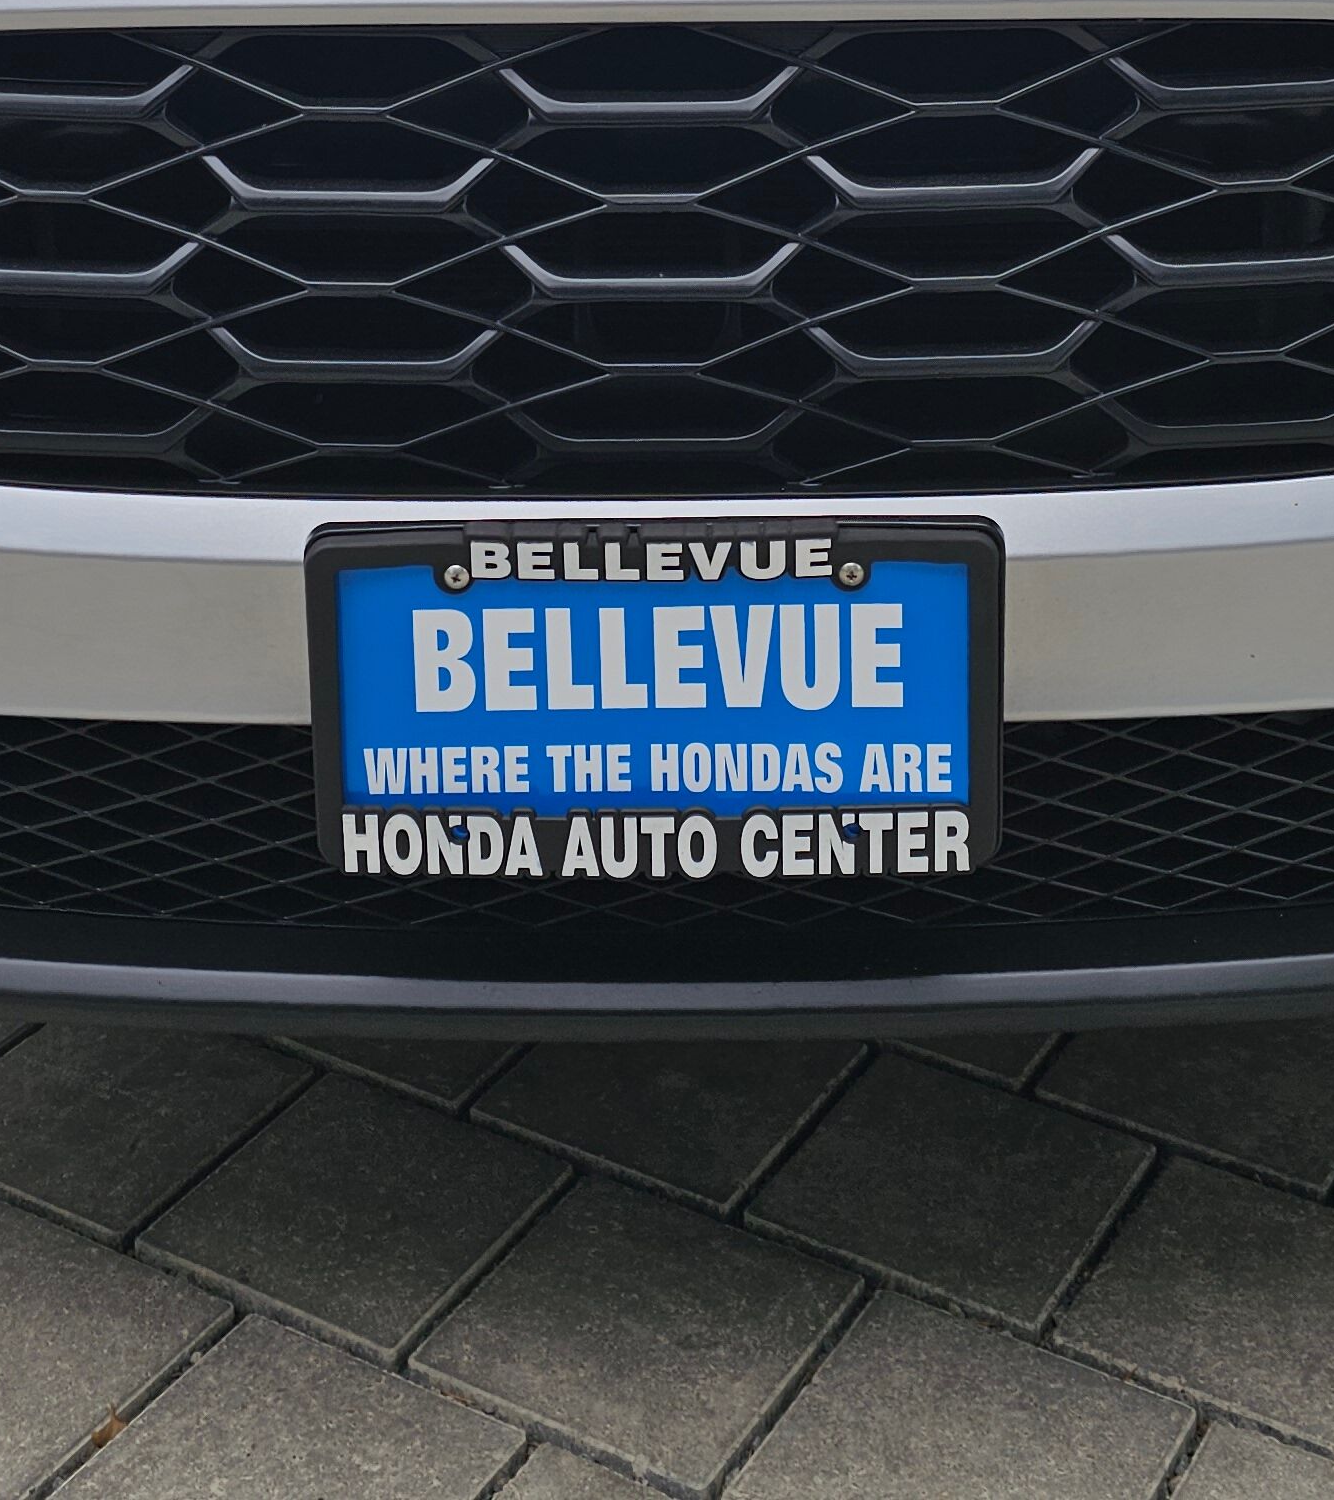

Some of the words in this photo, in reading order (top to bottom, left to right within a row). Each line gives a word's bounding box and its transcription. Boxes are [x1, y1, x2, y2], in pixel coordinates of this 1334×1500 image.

[470, 538, 835, 582] BELLEVUE
[411, 602, 905, 714] BELLEVUE
[363, 745, 531, 795] WHERE
[546, 743, 633, 794] THE
[650, 742, 844, 794] HONDAS
[860, 743, 953, 793] ARE
[342, 812, 544, 878] HONDA
[562, 812, 719, 878] AUTO
[740, 811, 971, 876] CENTER
